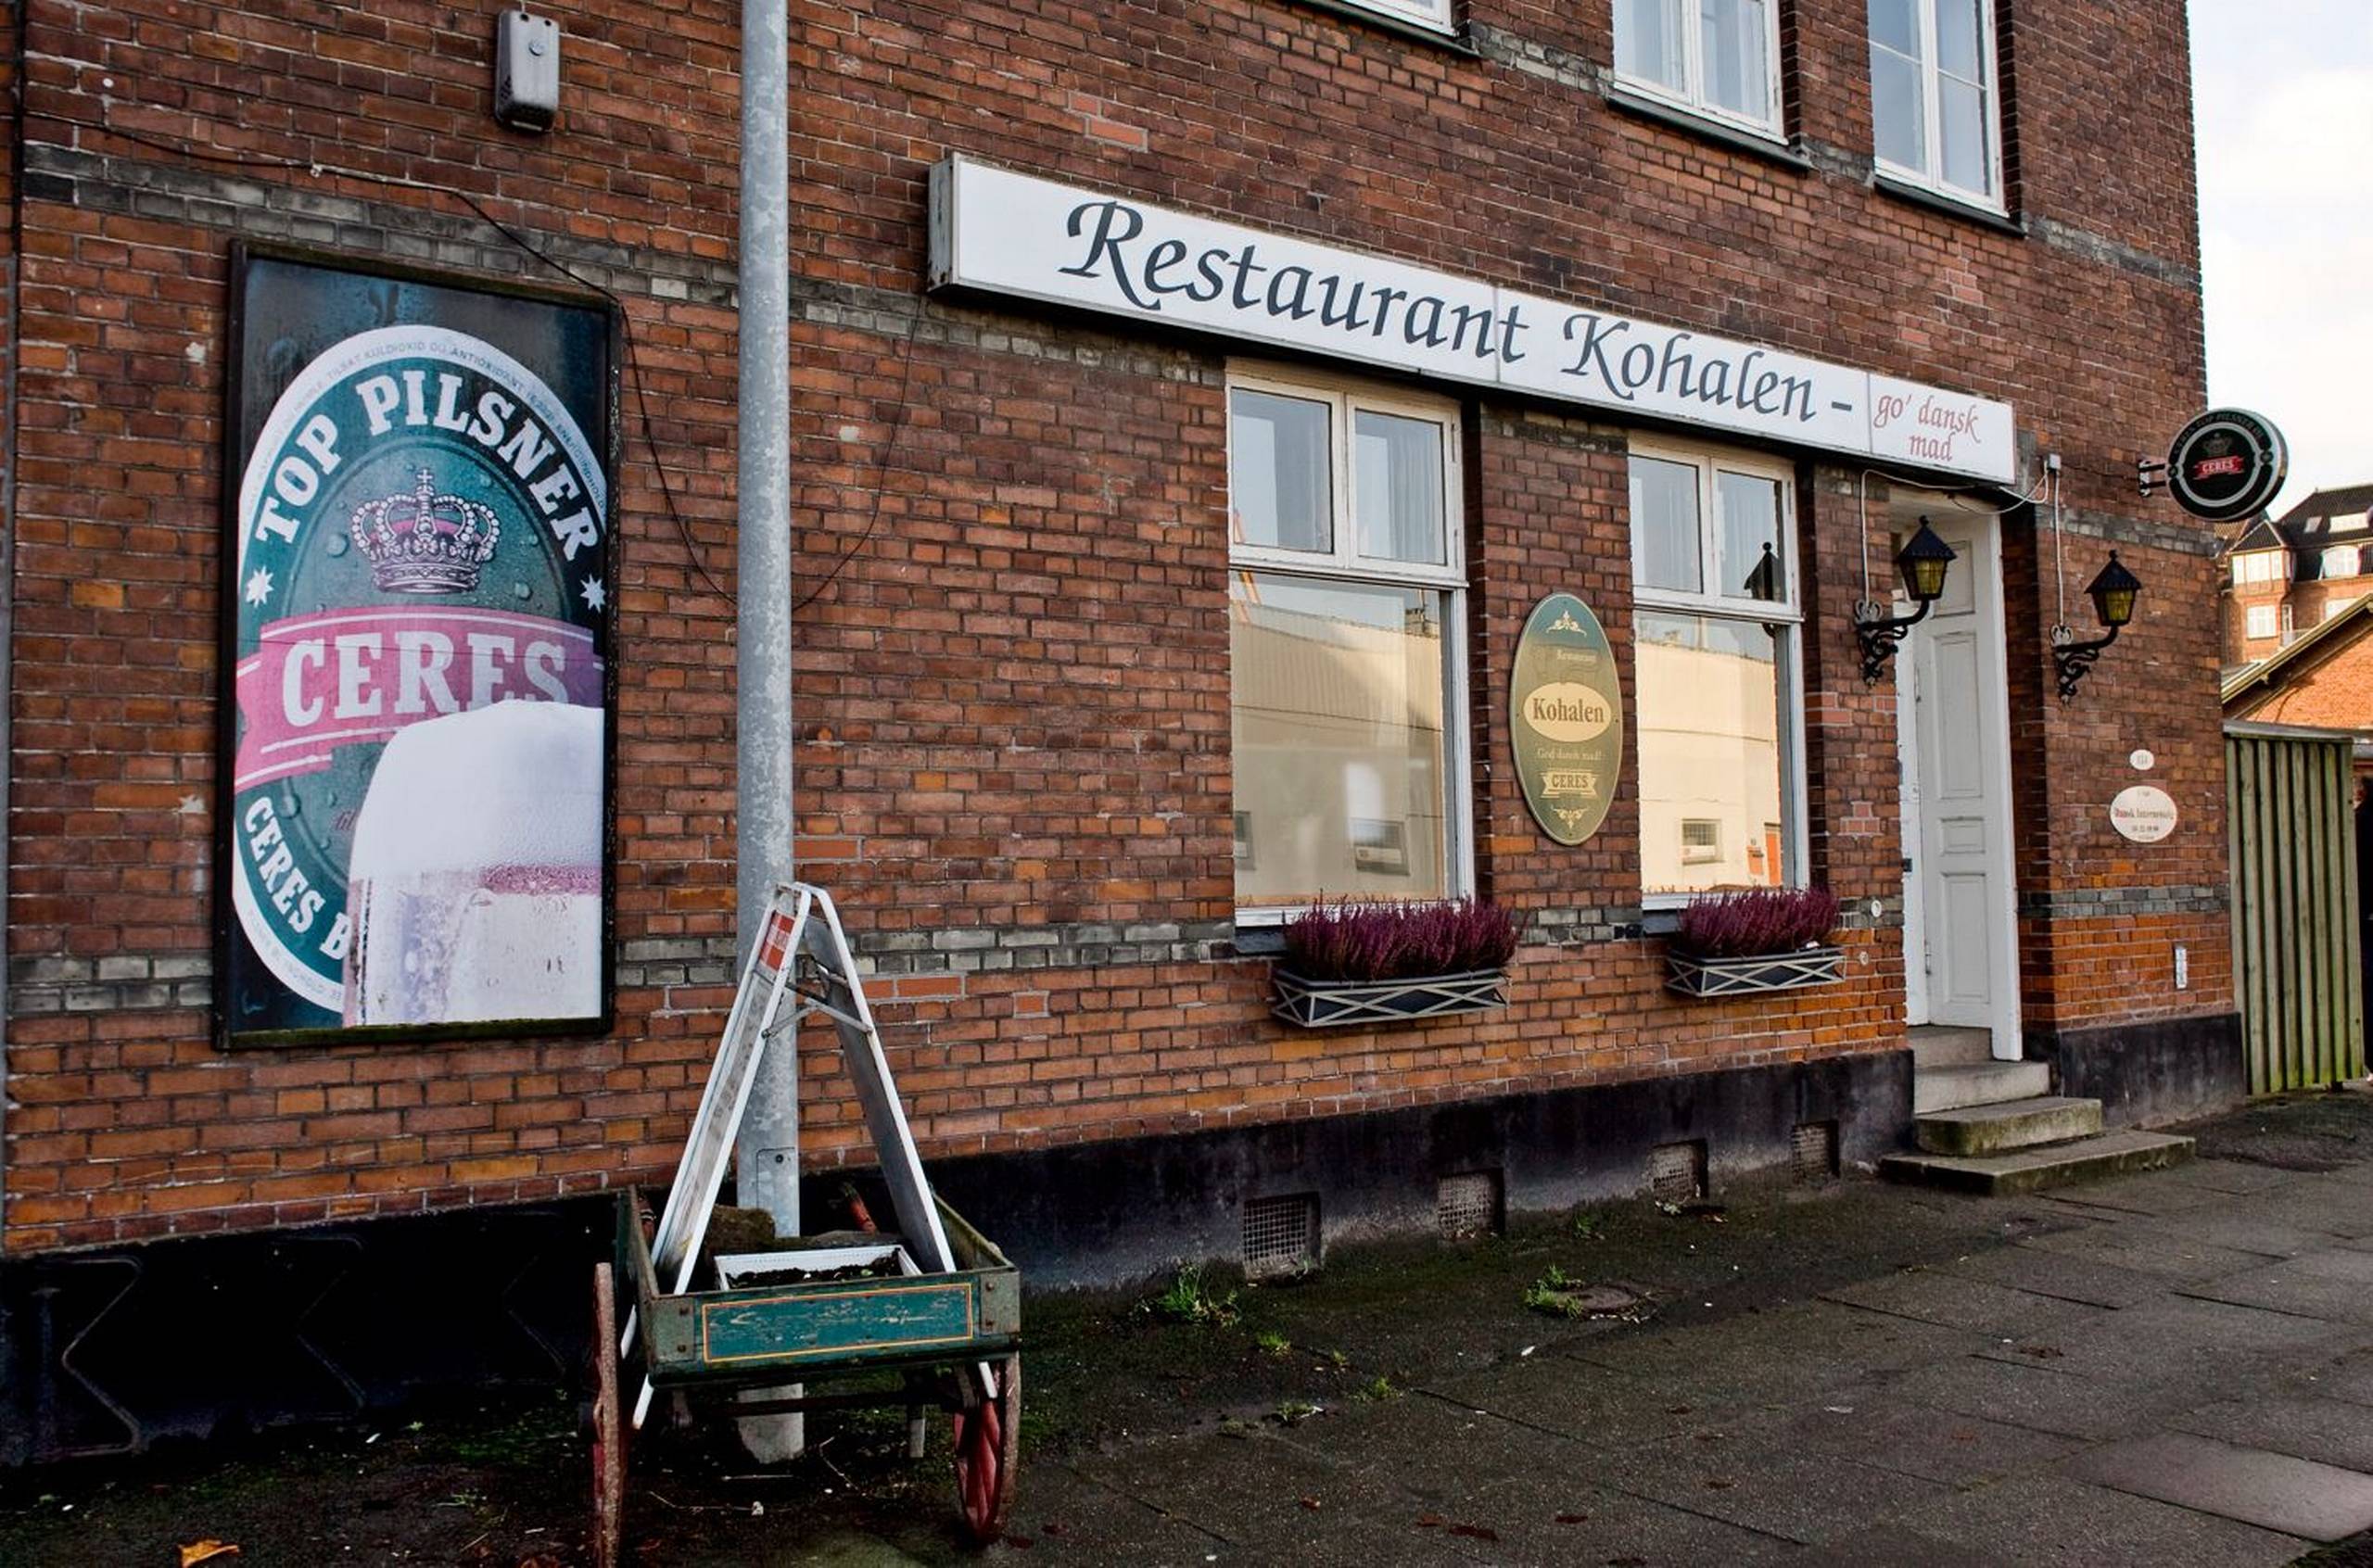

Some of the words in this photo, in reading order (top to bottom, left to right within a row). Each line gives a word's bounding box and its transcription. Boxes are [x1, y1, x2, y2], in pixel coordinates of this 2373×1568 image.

[1058, 200, 1531, 362] Restaurant
[1560, 313, 1819, 424] Kohalen
[1918, 393, 1982, 444] dansk
[255, 413, 342, 545] TOP
[355, 370, 601, 562] PILSNER
[1910, 430, 1955, 462] mad
[2202, 459, 2234, 474] CERES
[282, 629, 569, 727] CERES
[1532, 698, 1605, 723] Kohalen
[1552, 774, 1589, 788] CERES
[244, 796, 327, 934] CERES
